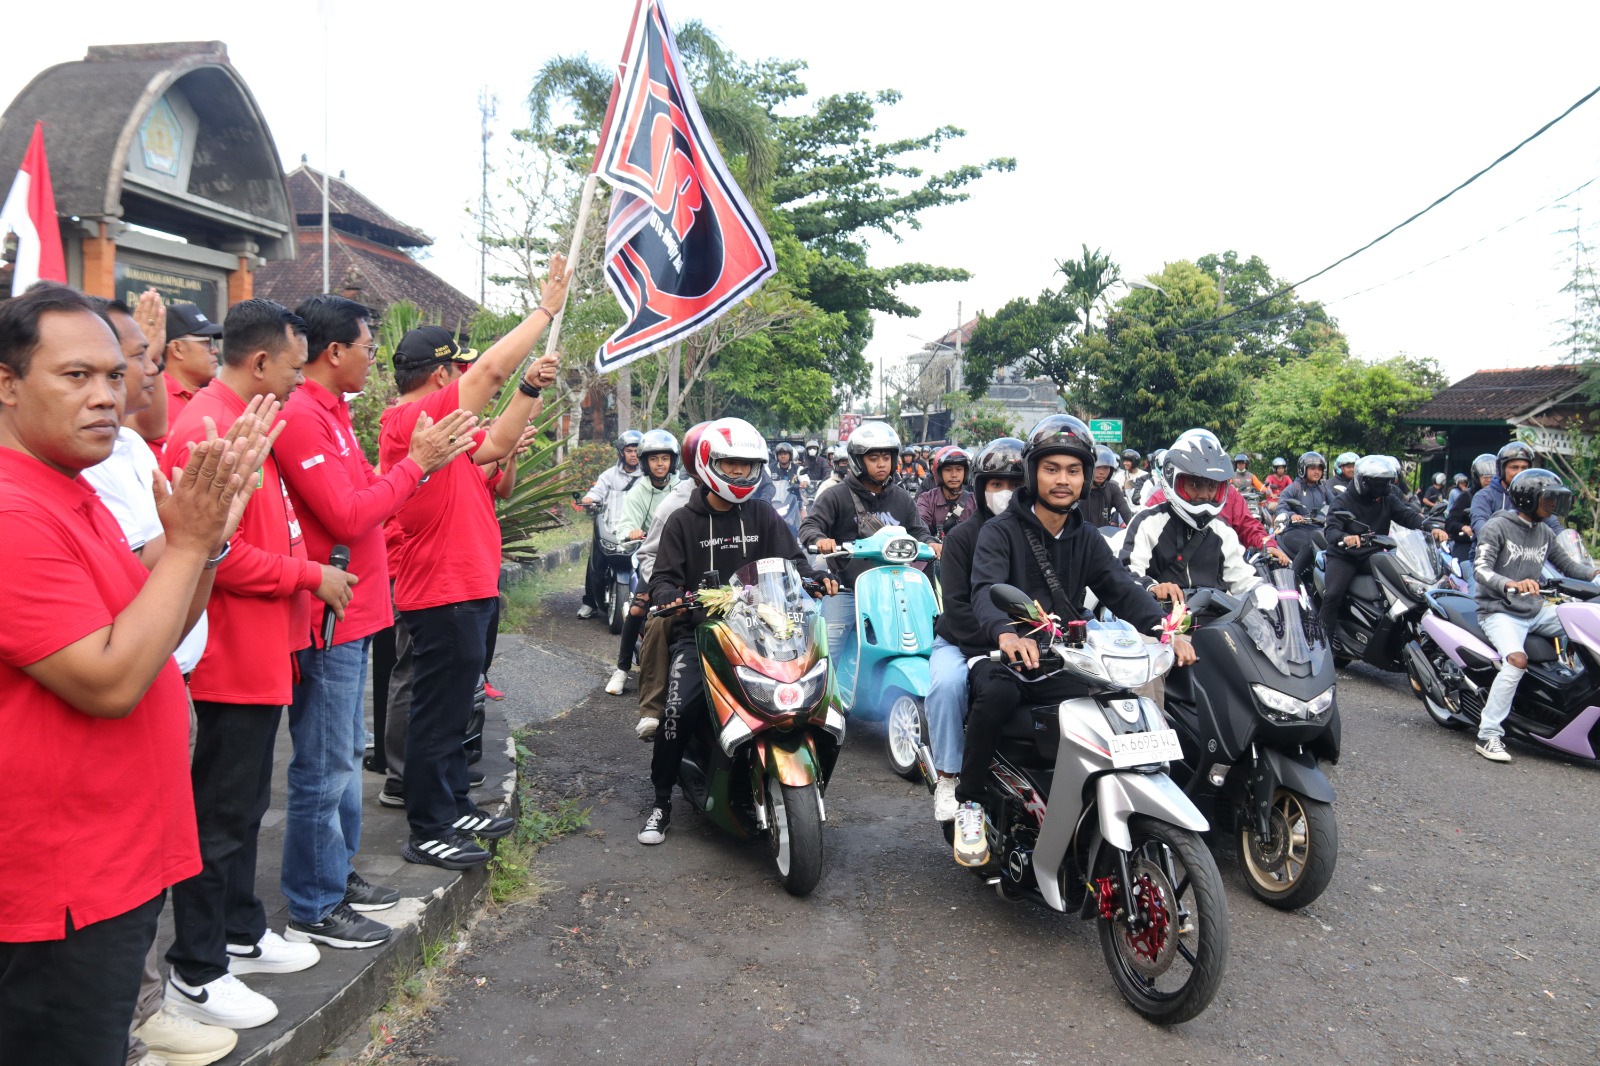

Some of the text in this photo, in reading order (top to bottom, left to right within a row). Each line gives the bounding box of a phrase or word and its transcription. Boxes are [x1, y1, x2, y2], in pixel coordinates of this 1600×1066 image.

[732, 535, 759, 543] HILIGER
[745, 615, 759, 628] DK
[664, 680, 682, 741] adidas
[1112, 738, 1129, 753] DK
[1130, 734, 1159, 750] 6695
